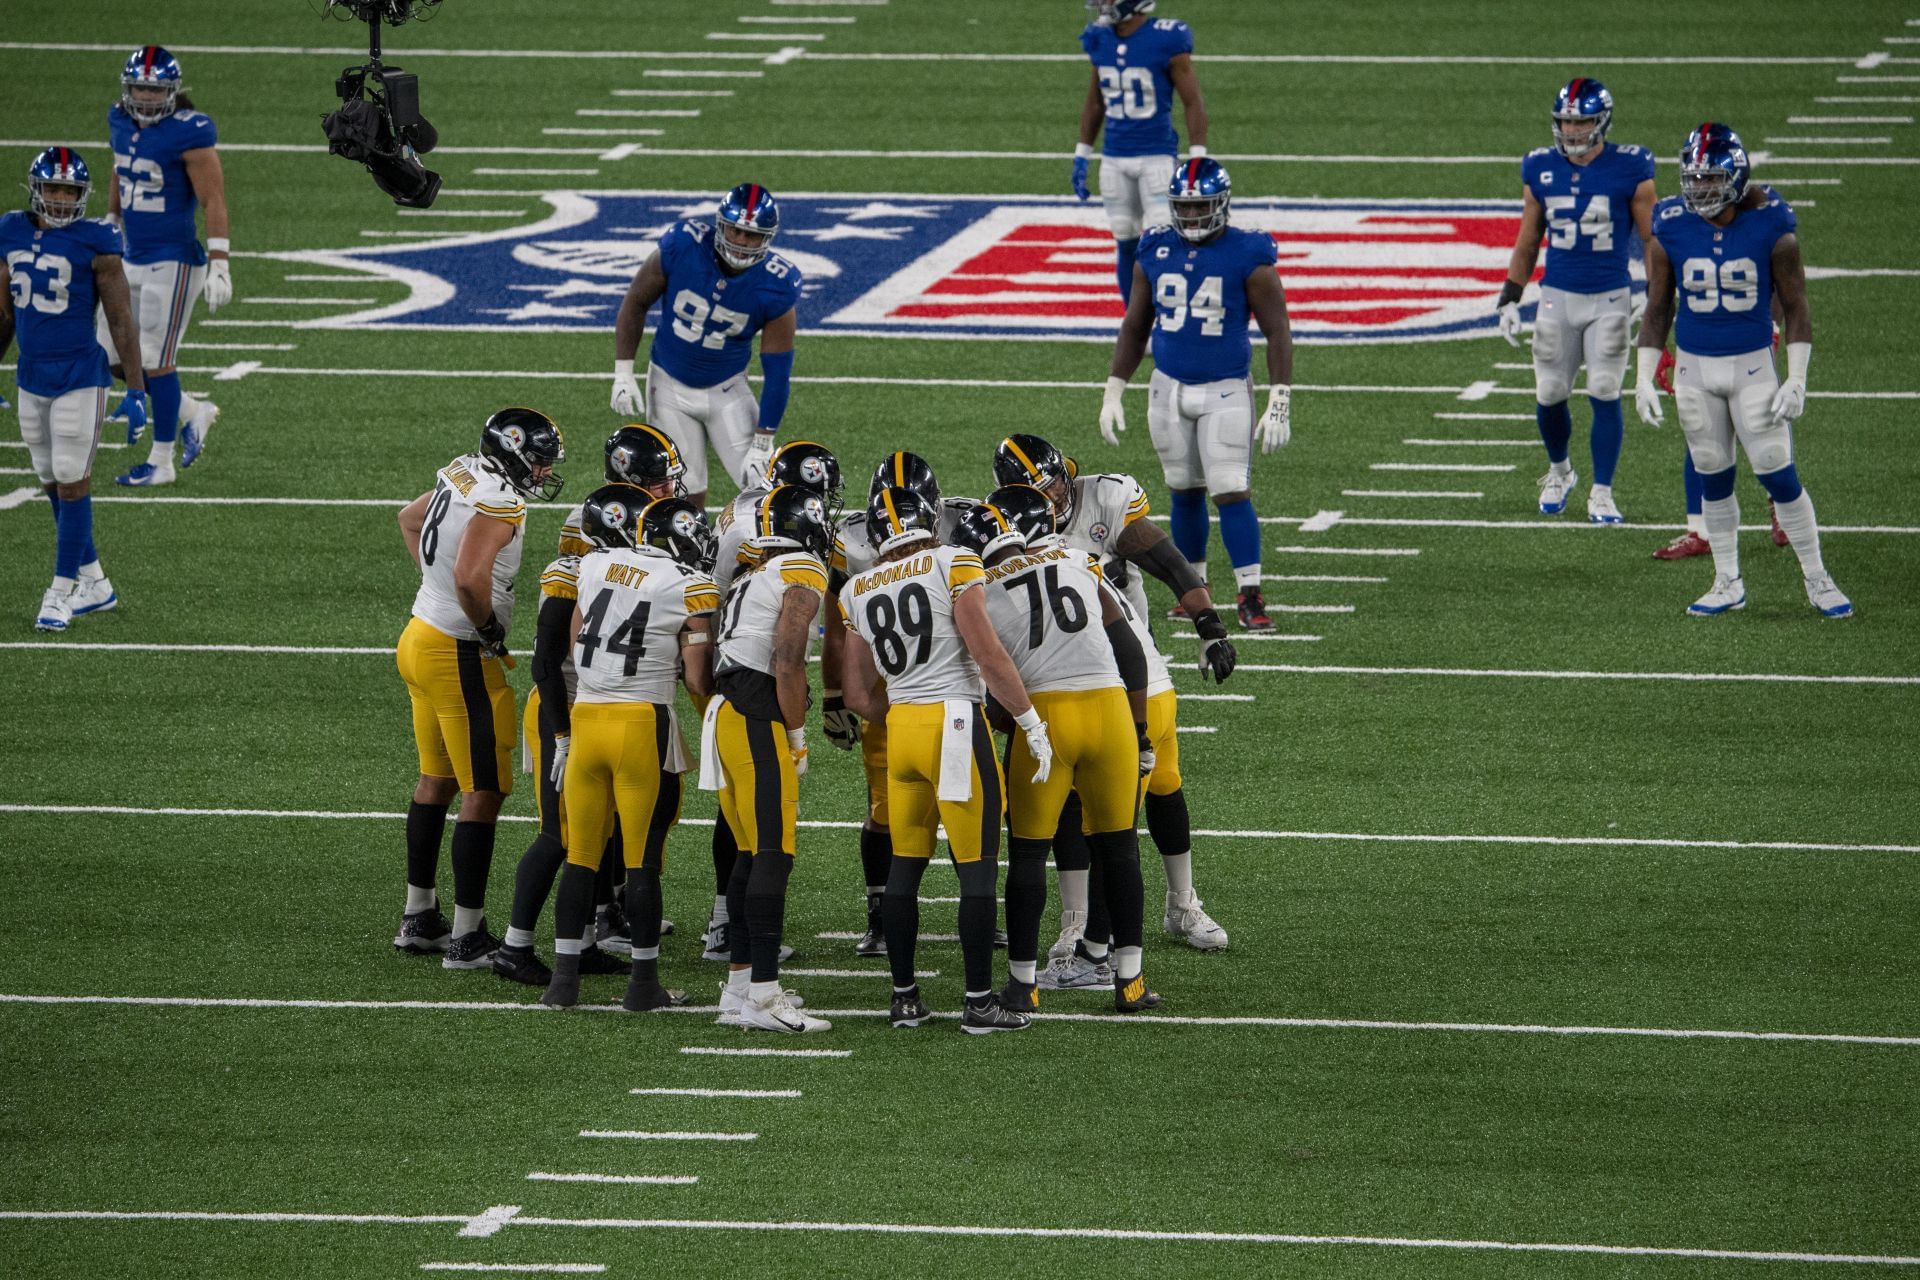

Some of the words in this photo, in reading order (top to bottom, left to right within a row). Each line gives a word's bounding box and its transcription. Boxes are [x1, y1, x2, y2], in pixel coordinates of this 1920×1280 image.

[1098, 66, 1157, 119] 20
[114, 152, 165, 212] 52
[1544, 195, 1613, 251] 54
[7, 250, 72, 314] 53
[1157, 273, 1225, 336] 94
[1683, 257, 1757, 313] 99
[672, 289, 750, 350] 97
[887, 517, 907, 537] 89
[605, 563, 649, 589] WATT
[854, 556, 932, 597] McDONALD
[576, 588, 651, 676] 44
[866, 582, 933, 676] 89
[1002, 564, 1088, 650] 76
